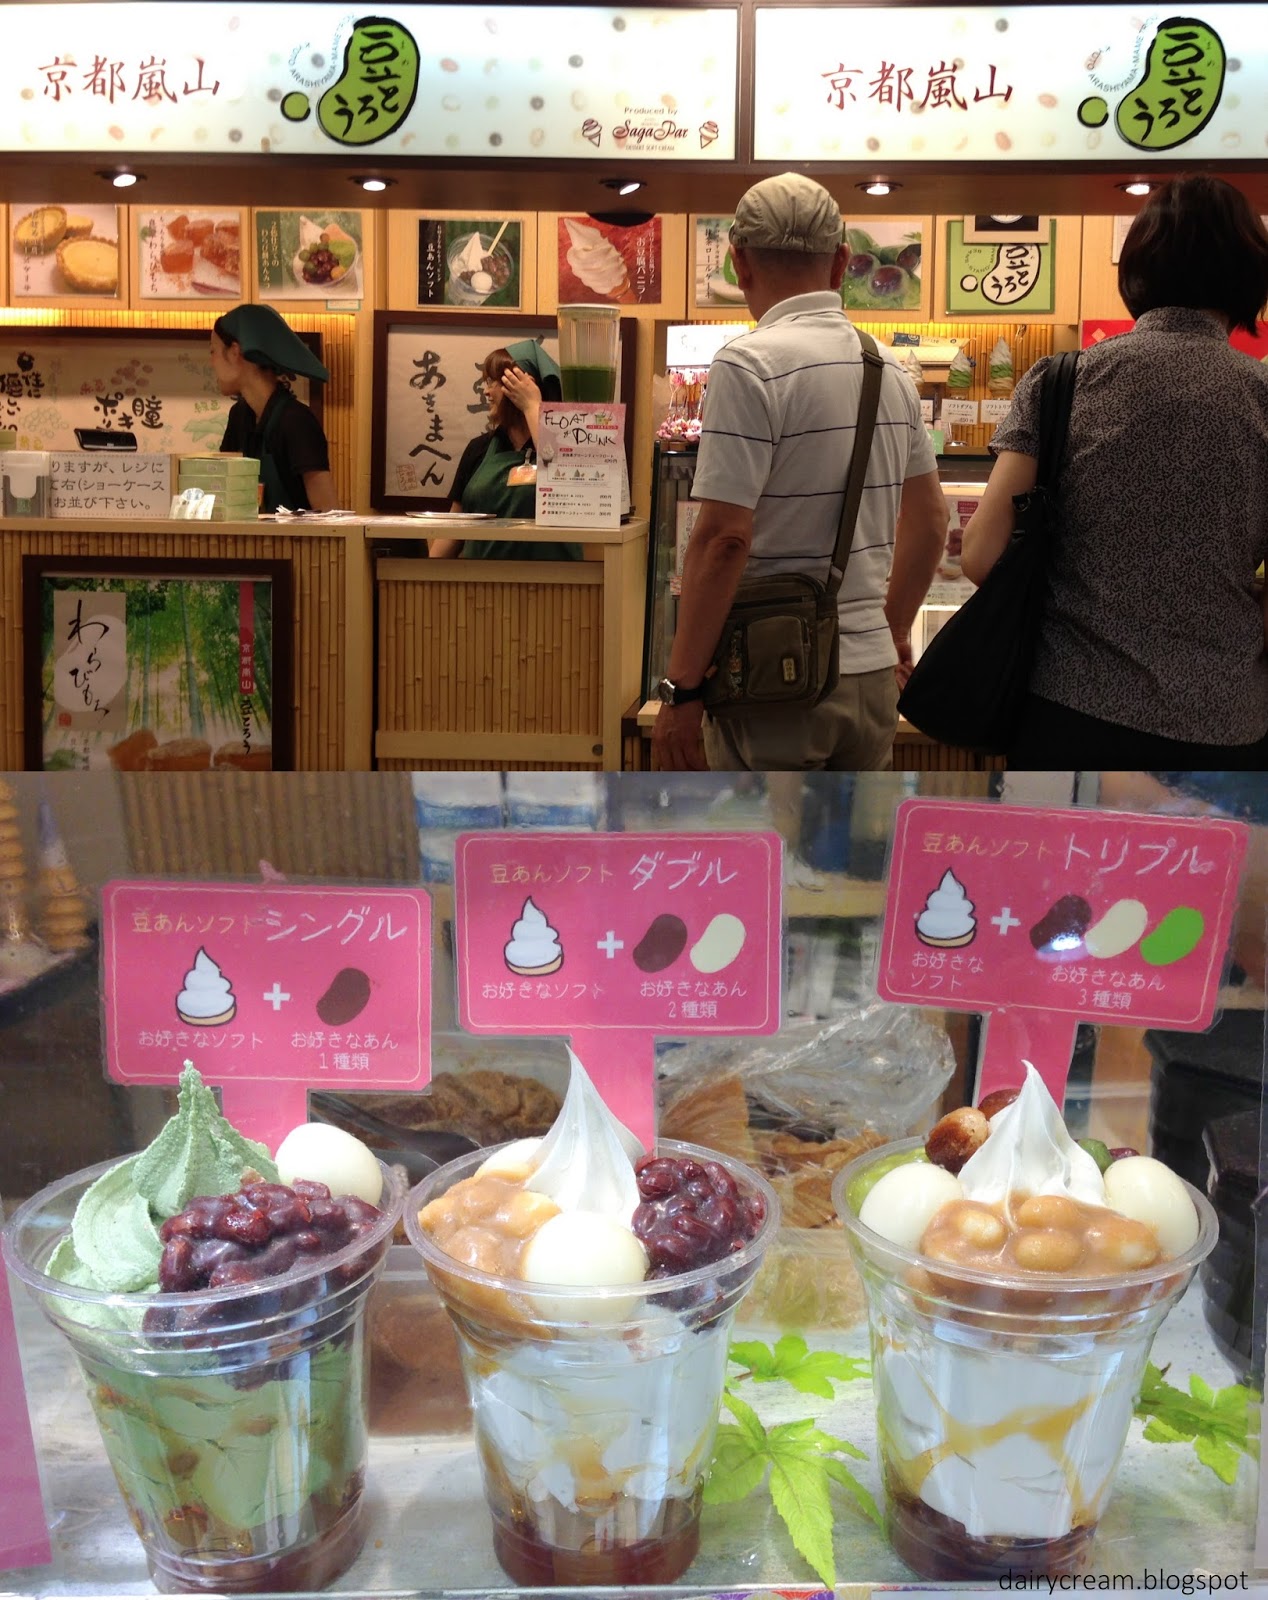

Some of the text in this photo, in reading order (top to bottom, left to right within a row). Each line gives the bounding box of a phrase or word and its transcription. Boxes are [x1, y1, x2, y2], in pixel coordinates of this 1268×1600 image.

[38, 54, 220, 104] 京都嵐山
[821, 59, 1013, 112] 京都嵐山
[426, 243, 435, 298] 豆あんソフト
[409, 350, 452, 487] あきまへん
[543, 409, 589, 429] FLOAT
[571, 428, 616, 446] DRINK
[54, 496, 151, 510] お並び下さい。
[67, 599, 110, 717] わらびもち
[922, 832, 1215, 876] 豆あんソフト トリプル
[490, 851, 738, 891] 豆あんソフト ダブル
[132, 906, 408, 945] 豆あんソフト シングル
[911, 951, 984, 974] お好きな
[640, 980, 748, 998] お好きなあん
[910, 975, 962, 993] ソフト
[1052, 965, 1166, 991] お好きなあん
[482, 980, 605, 1000] お好きなソフト
[1078, 989, 1132, 1011] 3種類
[668, 1001, 718, 1019] 2種類
[138, 1031, 264, 1050] お好きなソフト
[291, 1031, 399, 1050] お好きなあん
[319, 1052, 370, 1071] 1種類
